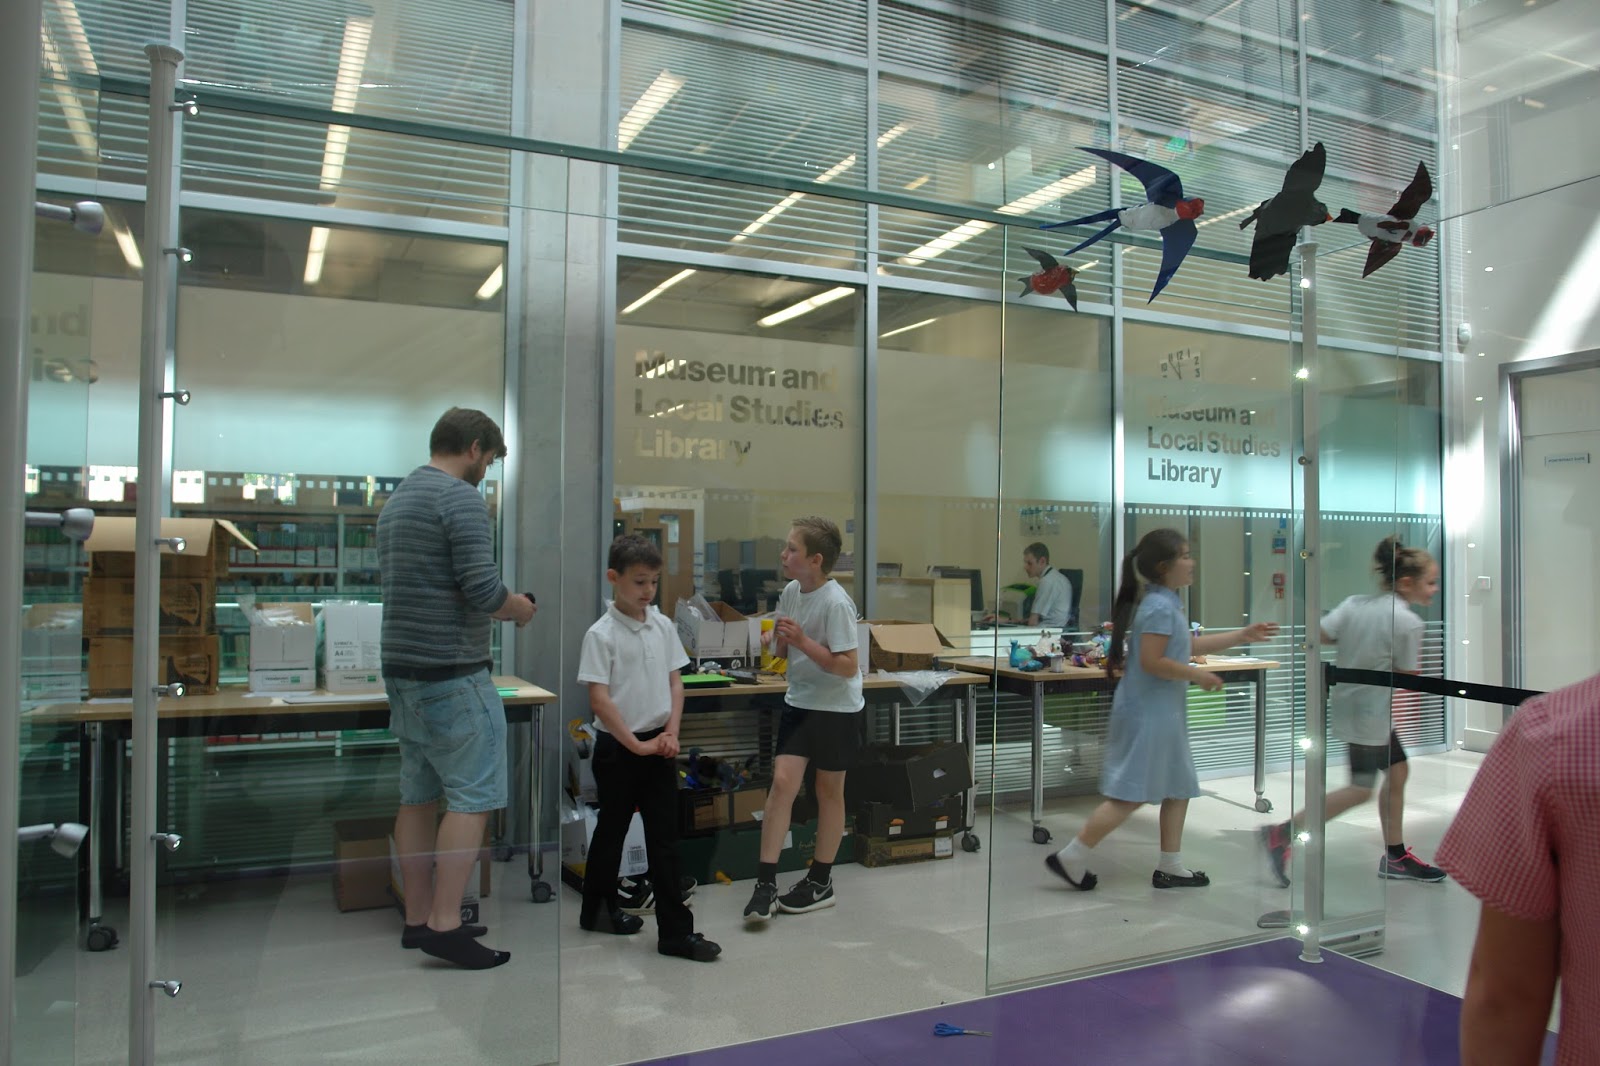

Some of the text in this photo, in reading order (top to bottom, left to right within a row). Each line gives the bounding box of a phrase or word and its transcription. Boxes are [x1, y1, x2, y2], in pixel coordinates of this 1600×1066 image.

[634, 349, 839, 393] Museum and
[634, 387, 844, 429] Local Studies
[634, 429, 752, 468] Library
[1148, 426, 1281, 457] Local Studies
[1148, 458, 1222, 488] Library
